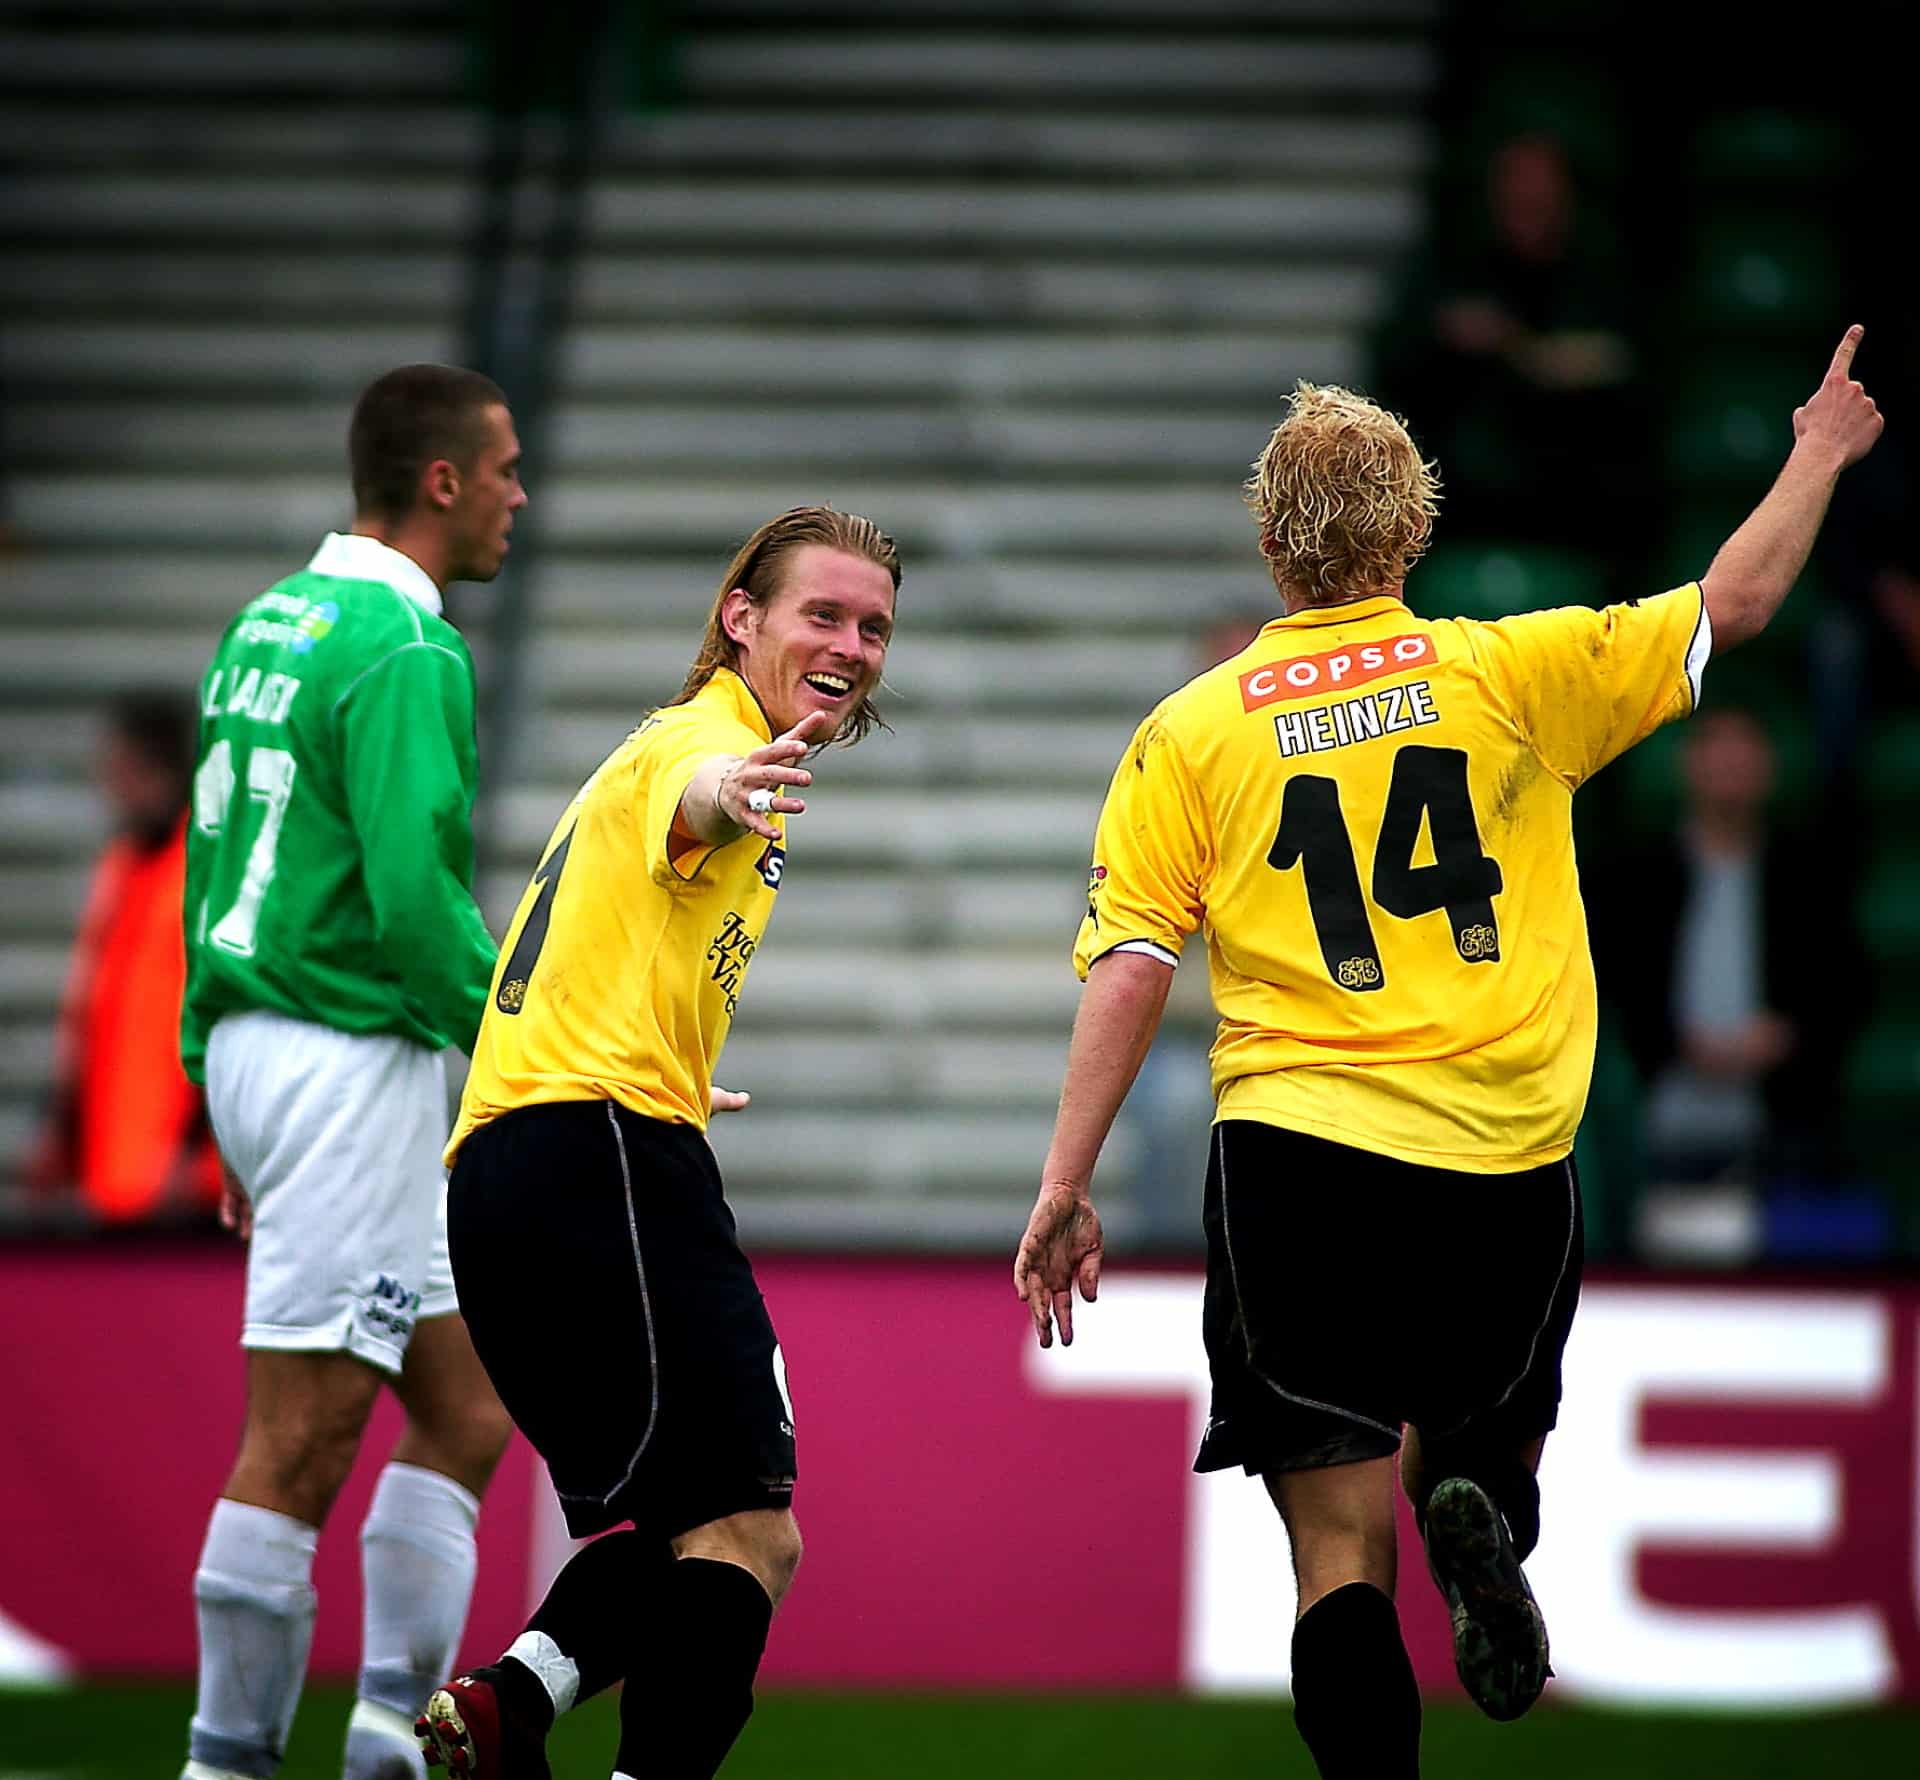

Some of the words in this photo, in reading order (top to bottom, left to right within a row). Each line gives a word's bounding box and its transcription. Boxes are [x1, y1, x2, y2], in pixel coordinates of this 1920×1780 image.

[1274, 681, 1439, 758] HEINZE
[1267, 744, 1503, 991] 14
[1024, 1266, 1920, 1716] TE
